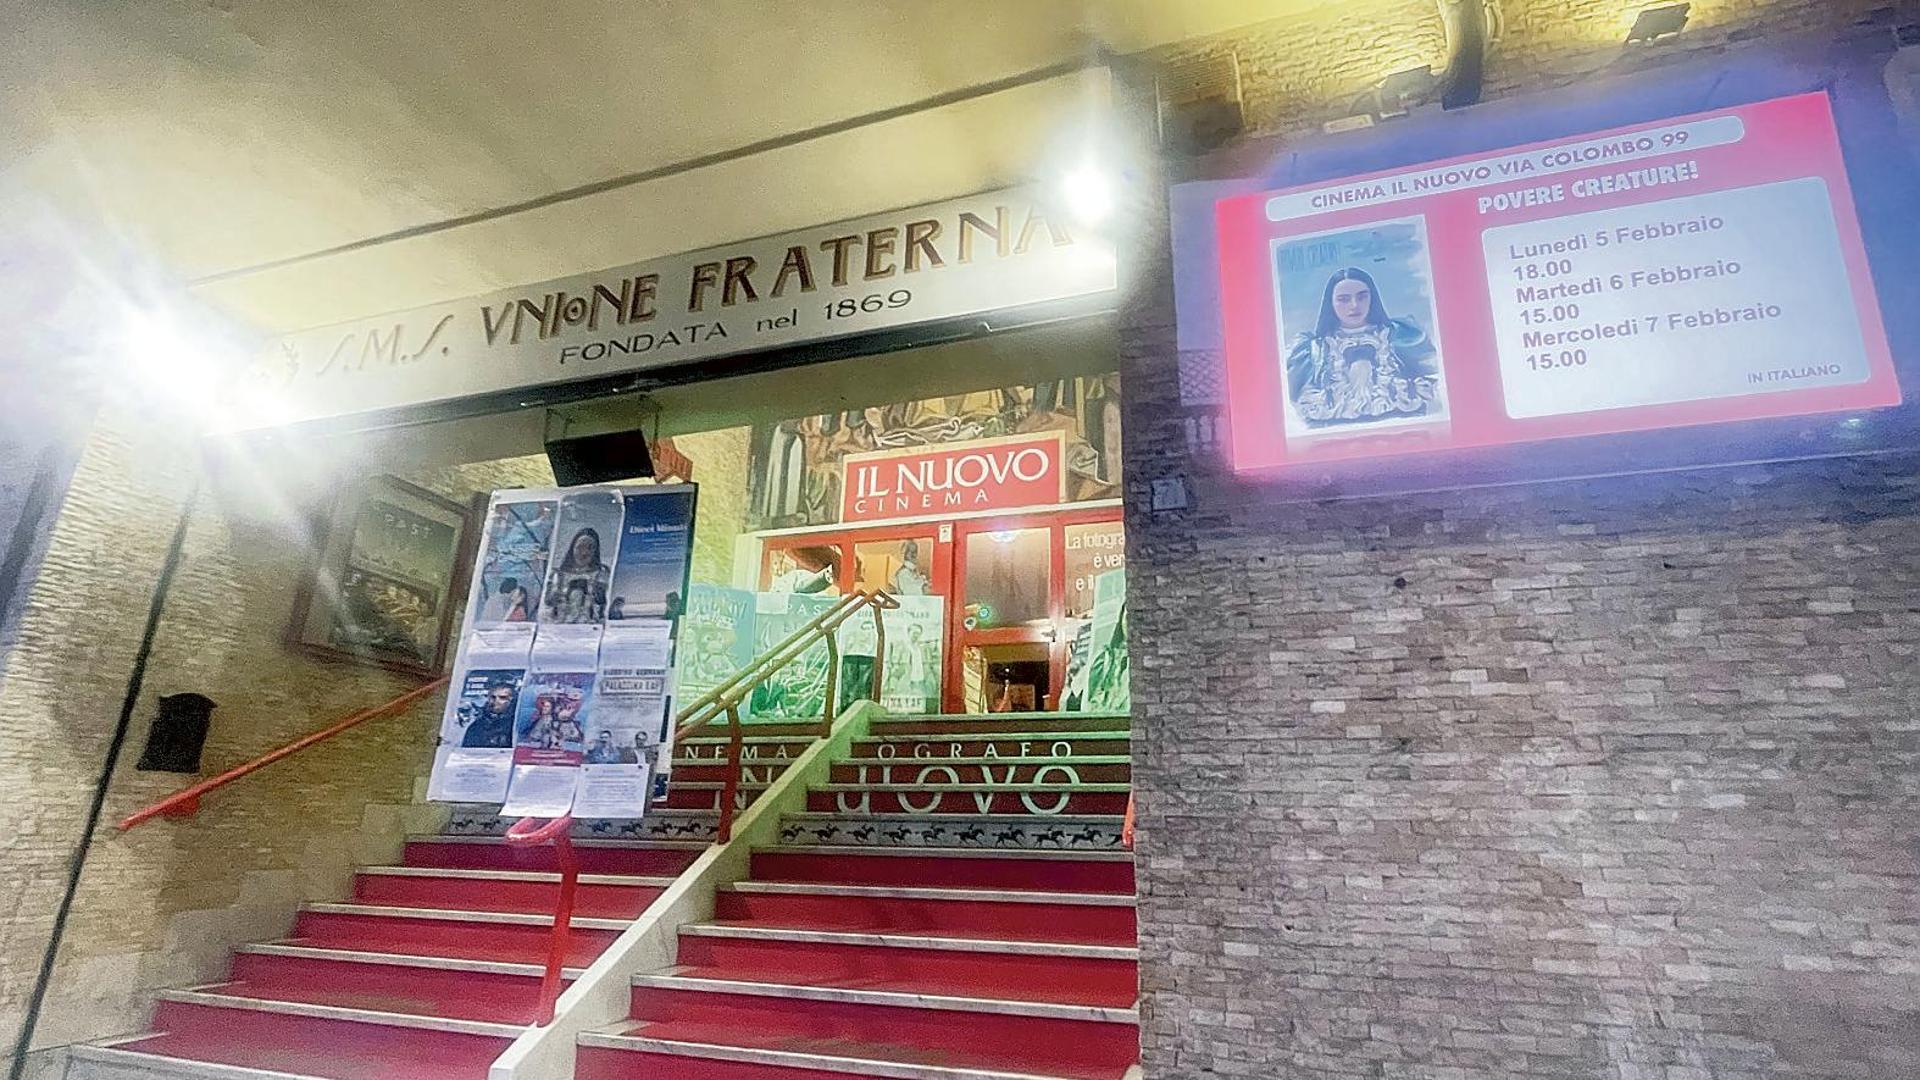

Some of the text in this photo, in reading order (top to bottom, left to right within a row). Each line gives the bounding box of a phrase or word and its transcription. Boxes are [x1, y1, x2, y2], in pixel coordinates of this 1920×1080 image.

[1311, 130, 1690, 209] CINEMA IL NUOVO VIA COLOMBO 99
[1479, 160, 1699, 214] POVERE CREATURE!
[1510, 216, 1724, 259] Lunedì 5 Febbraio
[687, 203, 1074, 313] FRATERNA
[1513, 258, 1572, 281] 18.00
[1516, 259, 1741, 303] Martedì 6 Febbraio
[560, 289, 912, 365] FONDATA nel 1869
[1520, 304, 1579, 325] 15.00
[1645, 316, 1658, 332] 7
[1668, 302, 1781, 330] Febbraio
[1527, 349, 1587, 370] 15.00
[1748, 363, 1841, 384] IN ITALIANO
[856, 448, 1049, 498] IL NUOVO
[854, 489, 989, 514] CINEMA
[1065, 534, 1081, 549] La
